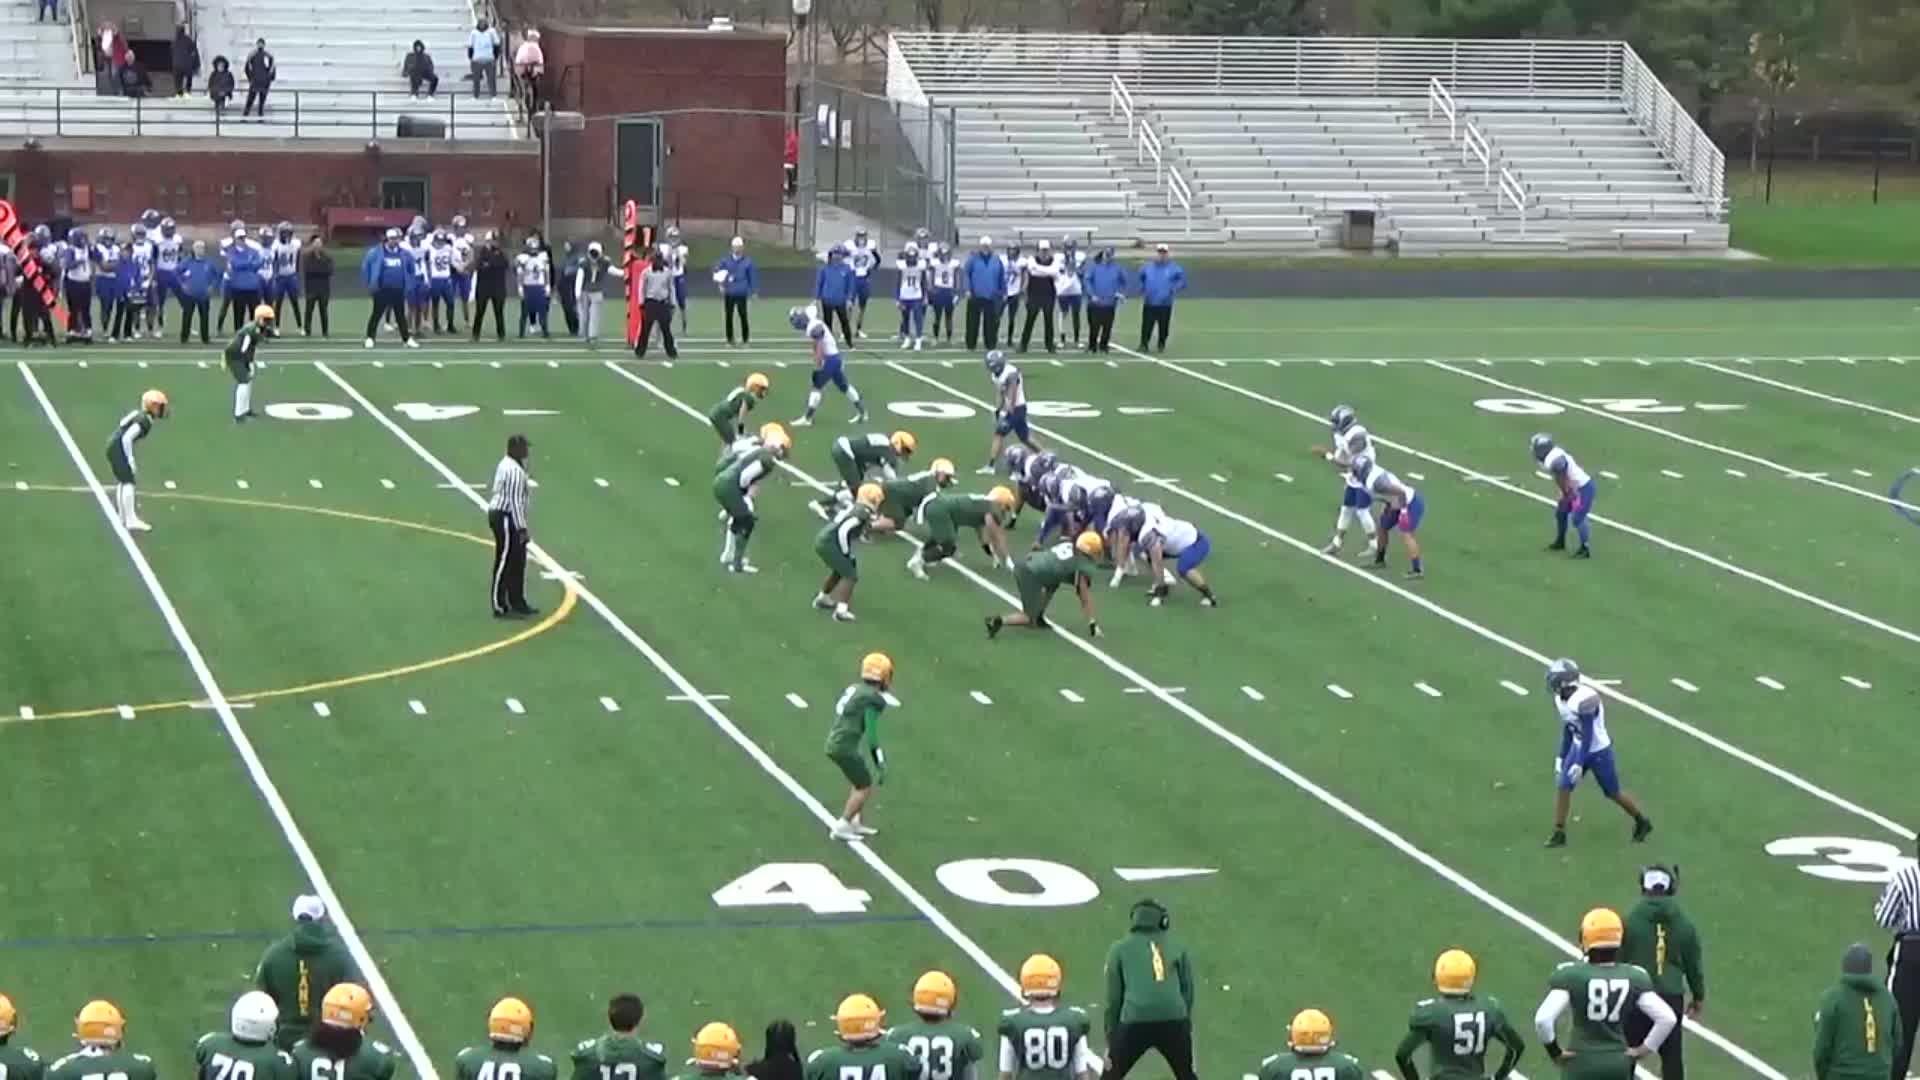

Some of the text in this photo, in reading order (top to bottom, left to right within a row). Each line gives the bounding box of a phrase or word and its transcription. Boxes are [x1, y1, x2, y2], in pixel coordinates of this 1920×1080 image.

[1587, 978, 1630, 1022] 87
[1023, 1026, 1068, 1070] 80
[1453, 1011, 1486, 1055] 51
[211, 1052, 255, 1080] 70
